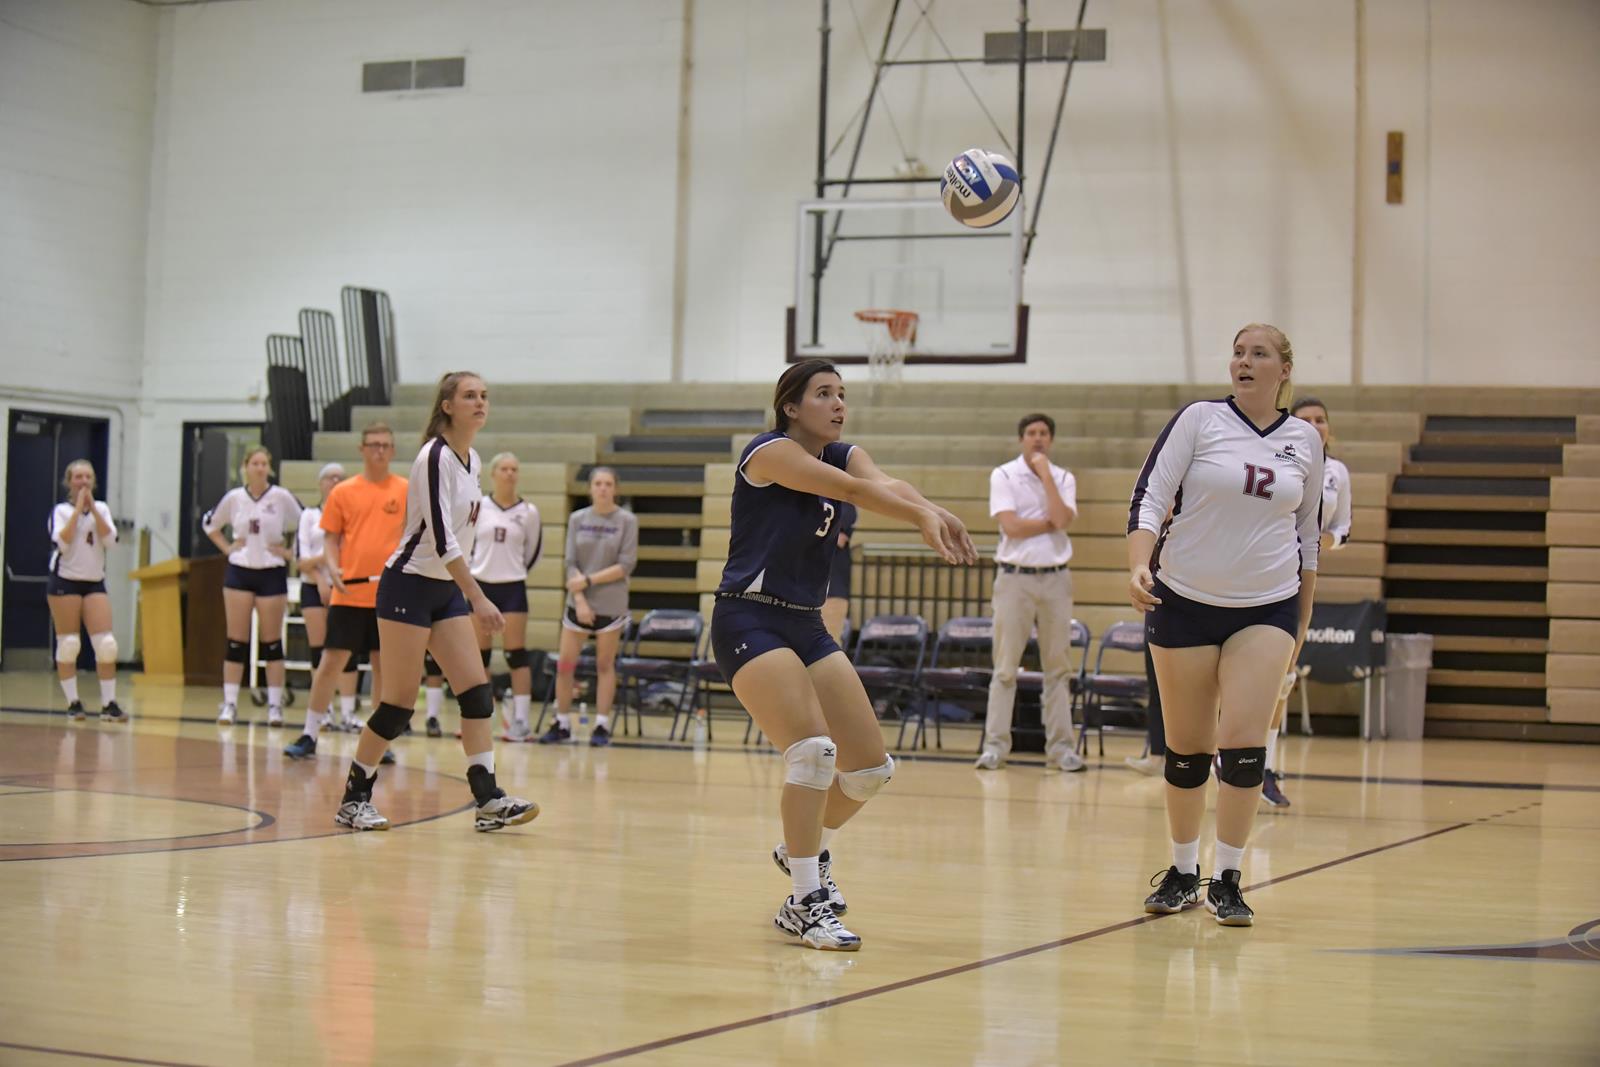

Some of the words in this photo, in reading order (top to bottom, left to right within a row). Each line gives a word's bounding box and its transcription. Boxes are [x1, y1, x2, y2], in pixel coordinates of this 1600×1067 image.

[1243, 462, 1276, 501] 12
[815, 502, 835, 537] 3
[86, 530, 95, 547] 4
[741, 592, 773, 605] ARMOUR
